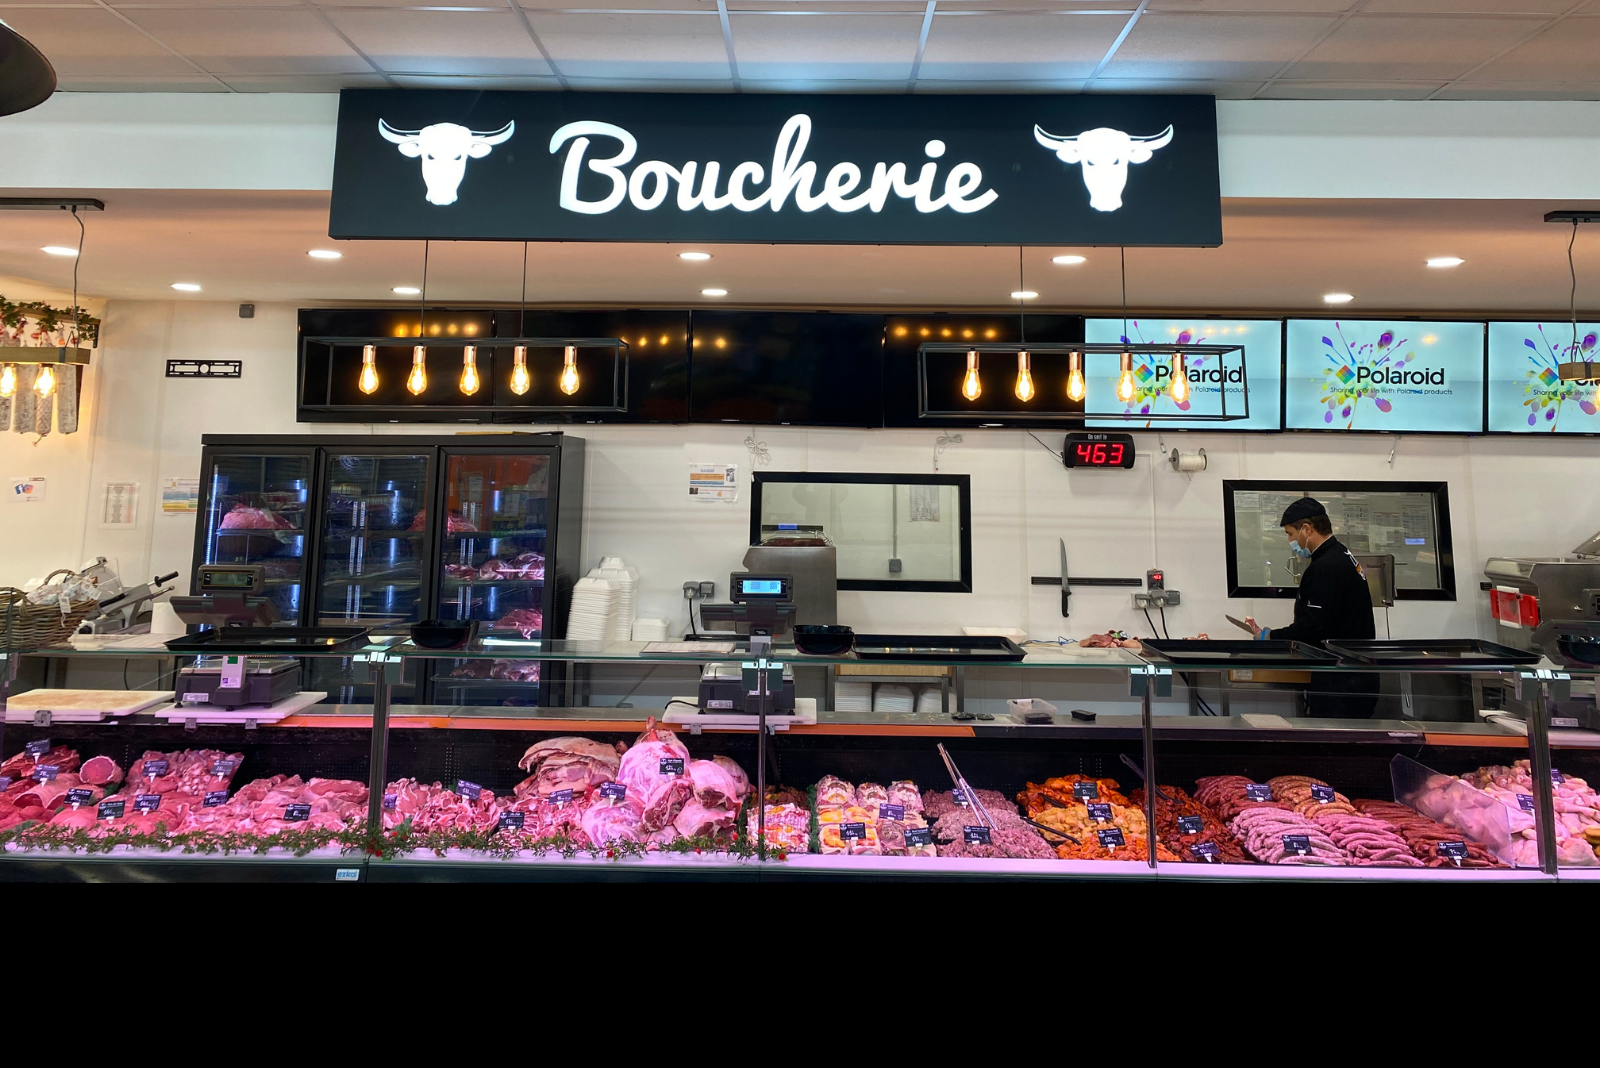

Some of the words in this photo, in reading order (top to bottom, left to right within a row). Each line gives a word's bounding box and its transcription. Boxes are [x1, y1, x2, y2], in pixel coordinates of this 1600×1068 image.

[549, 113, 998, 215] Boucherie
[1156, 365, 1242, 383] Plaroid
[1357, 366, 1445, 385] Polaroid
[1077, 444, 1124, 464] 463
